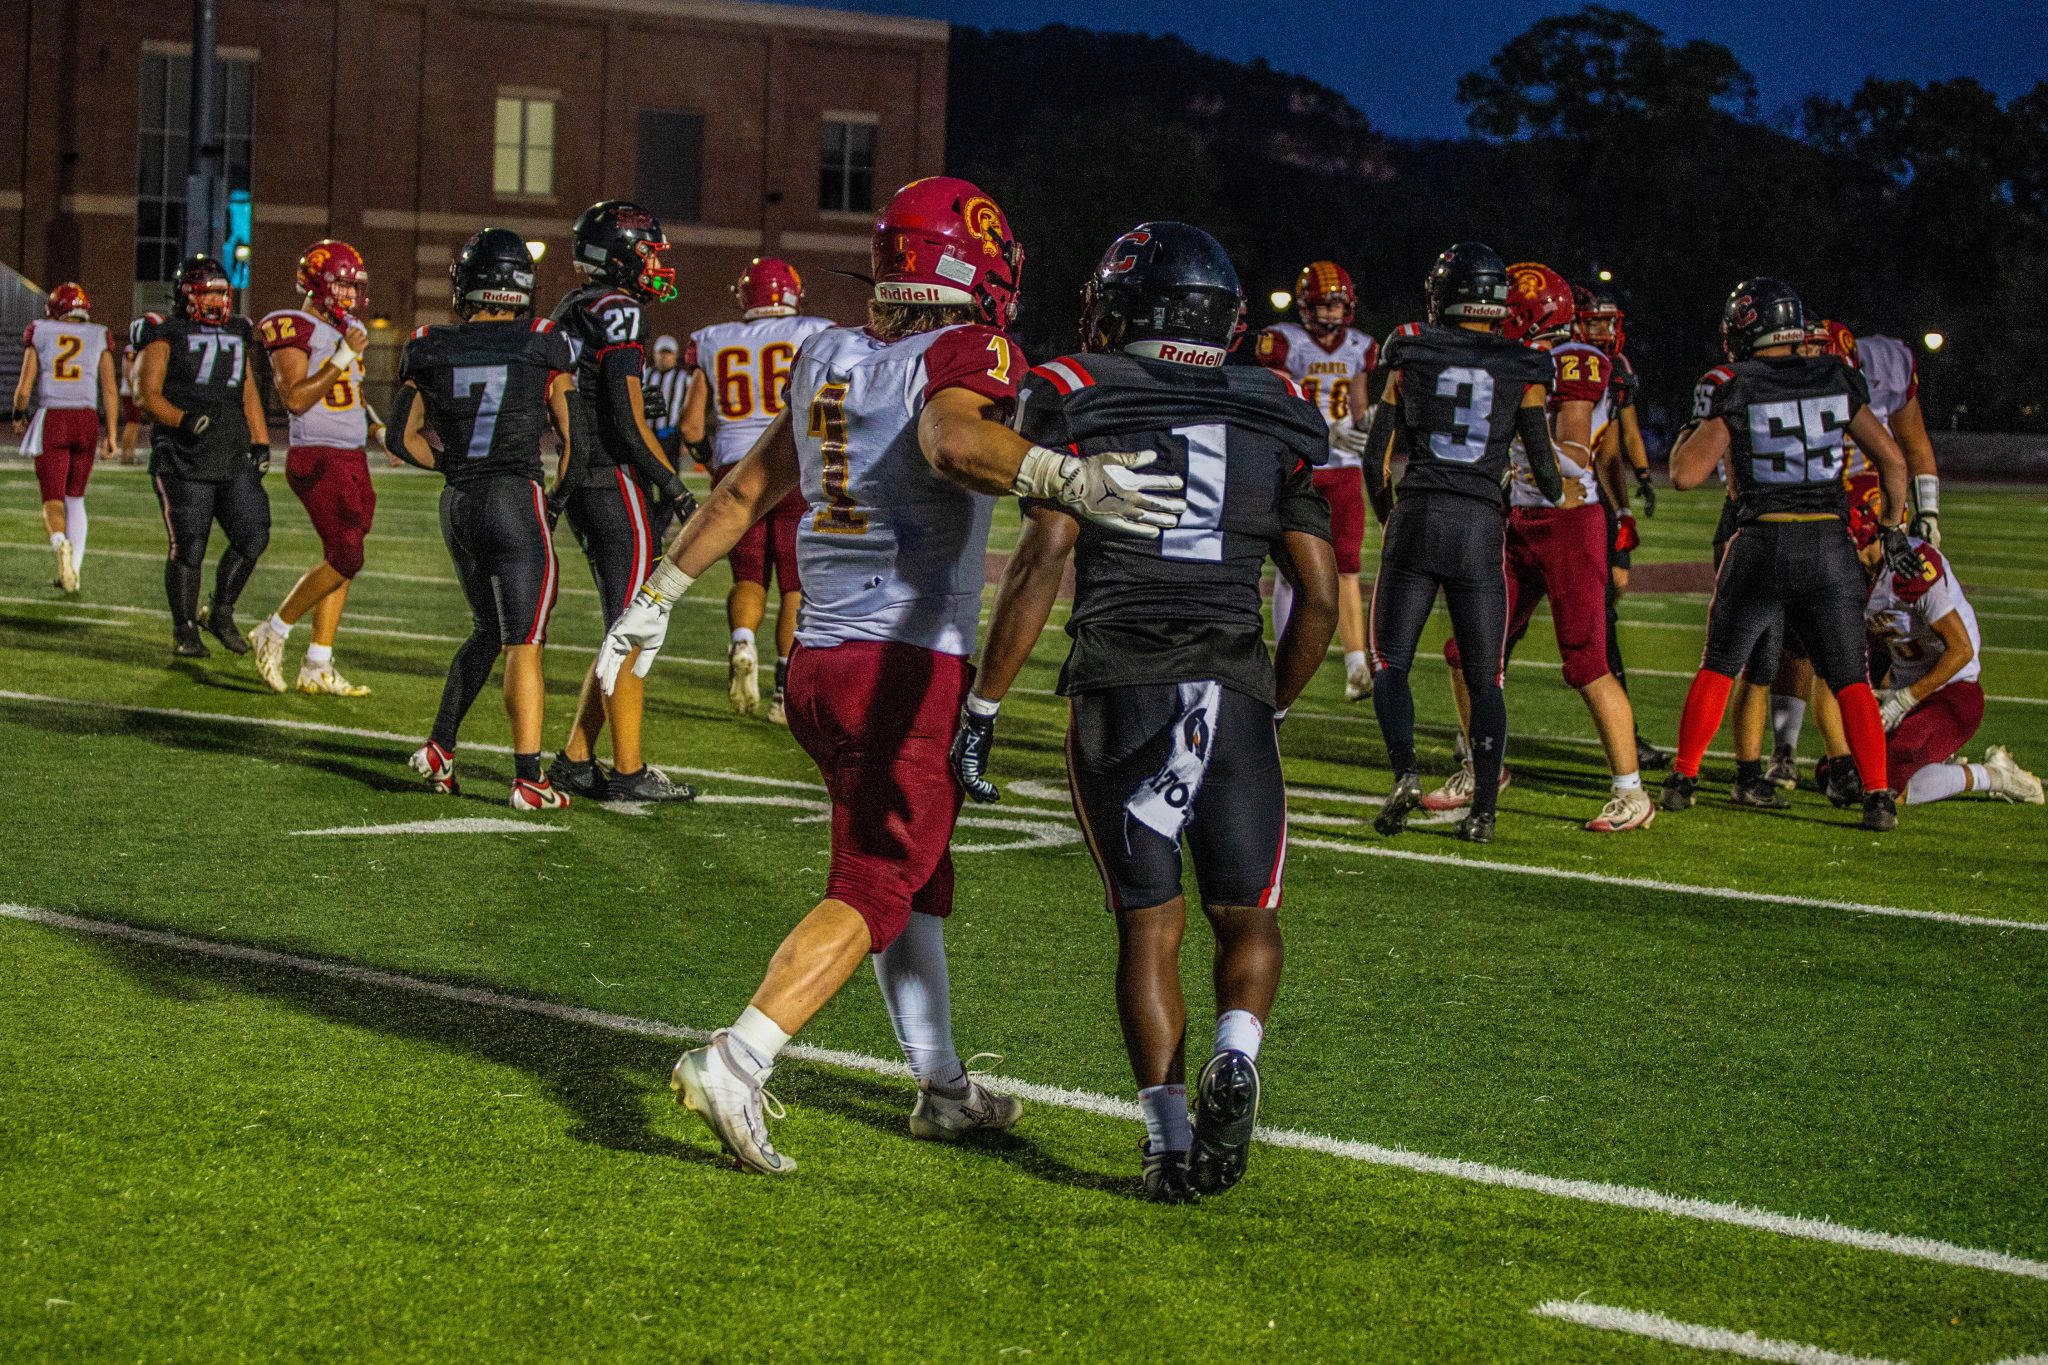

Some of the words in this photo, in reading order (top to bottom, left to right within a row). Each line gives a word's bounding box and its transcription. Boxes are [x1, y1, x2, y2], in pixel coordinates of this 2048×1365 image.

[482, 291, 522, 303] Riddell
[879, 286, 940, 301] Riddell
[1462, 305, 1502, 316] Riddell
[603, 307, 640, 341] 27
[53, 335, 83, 381] 2
[187, 333, 243, 387] 77
[715, 341, 796, 420] 66
[986, 334, 1011, 385] 1
[1158, 344, 1224, 367] Riddell
[1560, 355, 1601, 382] 21
[452, 364, 507, 458] 7
[1429, 366, 1494, 462] 3
[807, 383, 868, 534] 1
[1748, 394, 1850, 482] 55
[1162, 423, 1227, 560] 1
